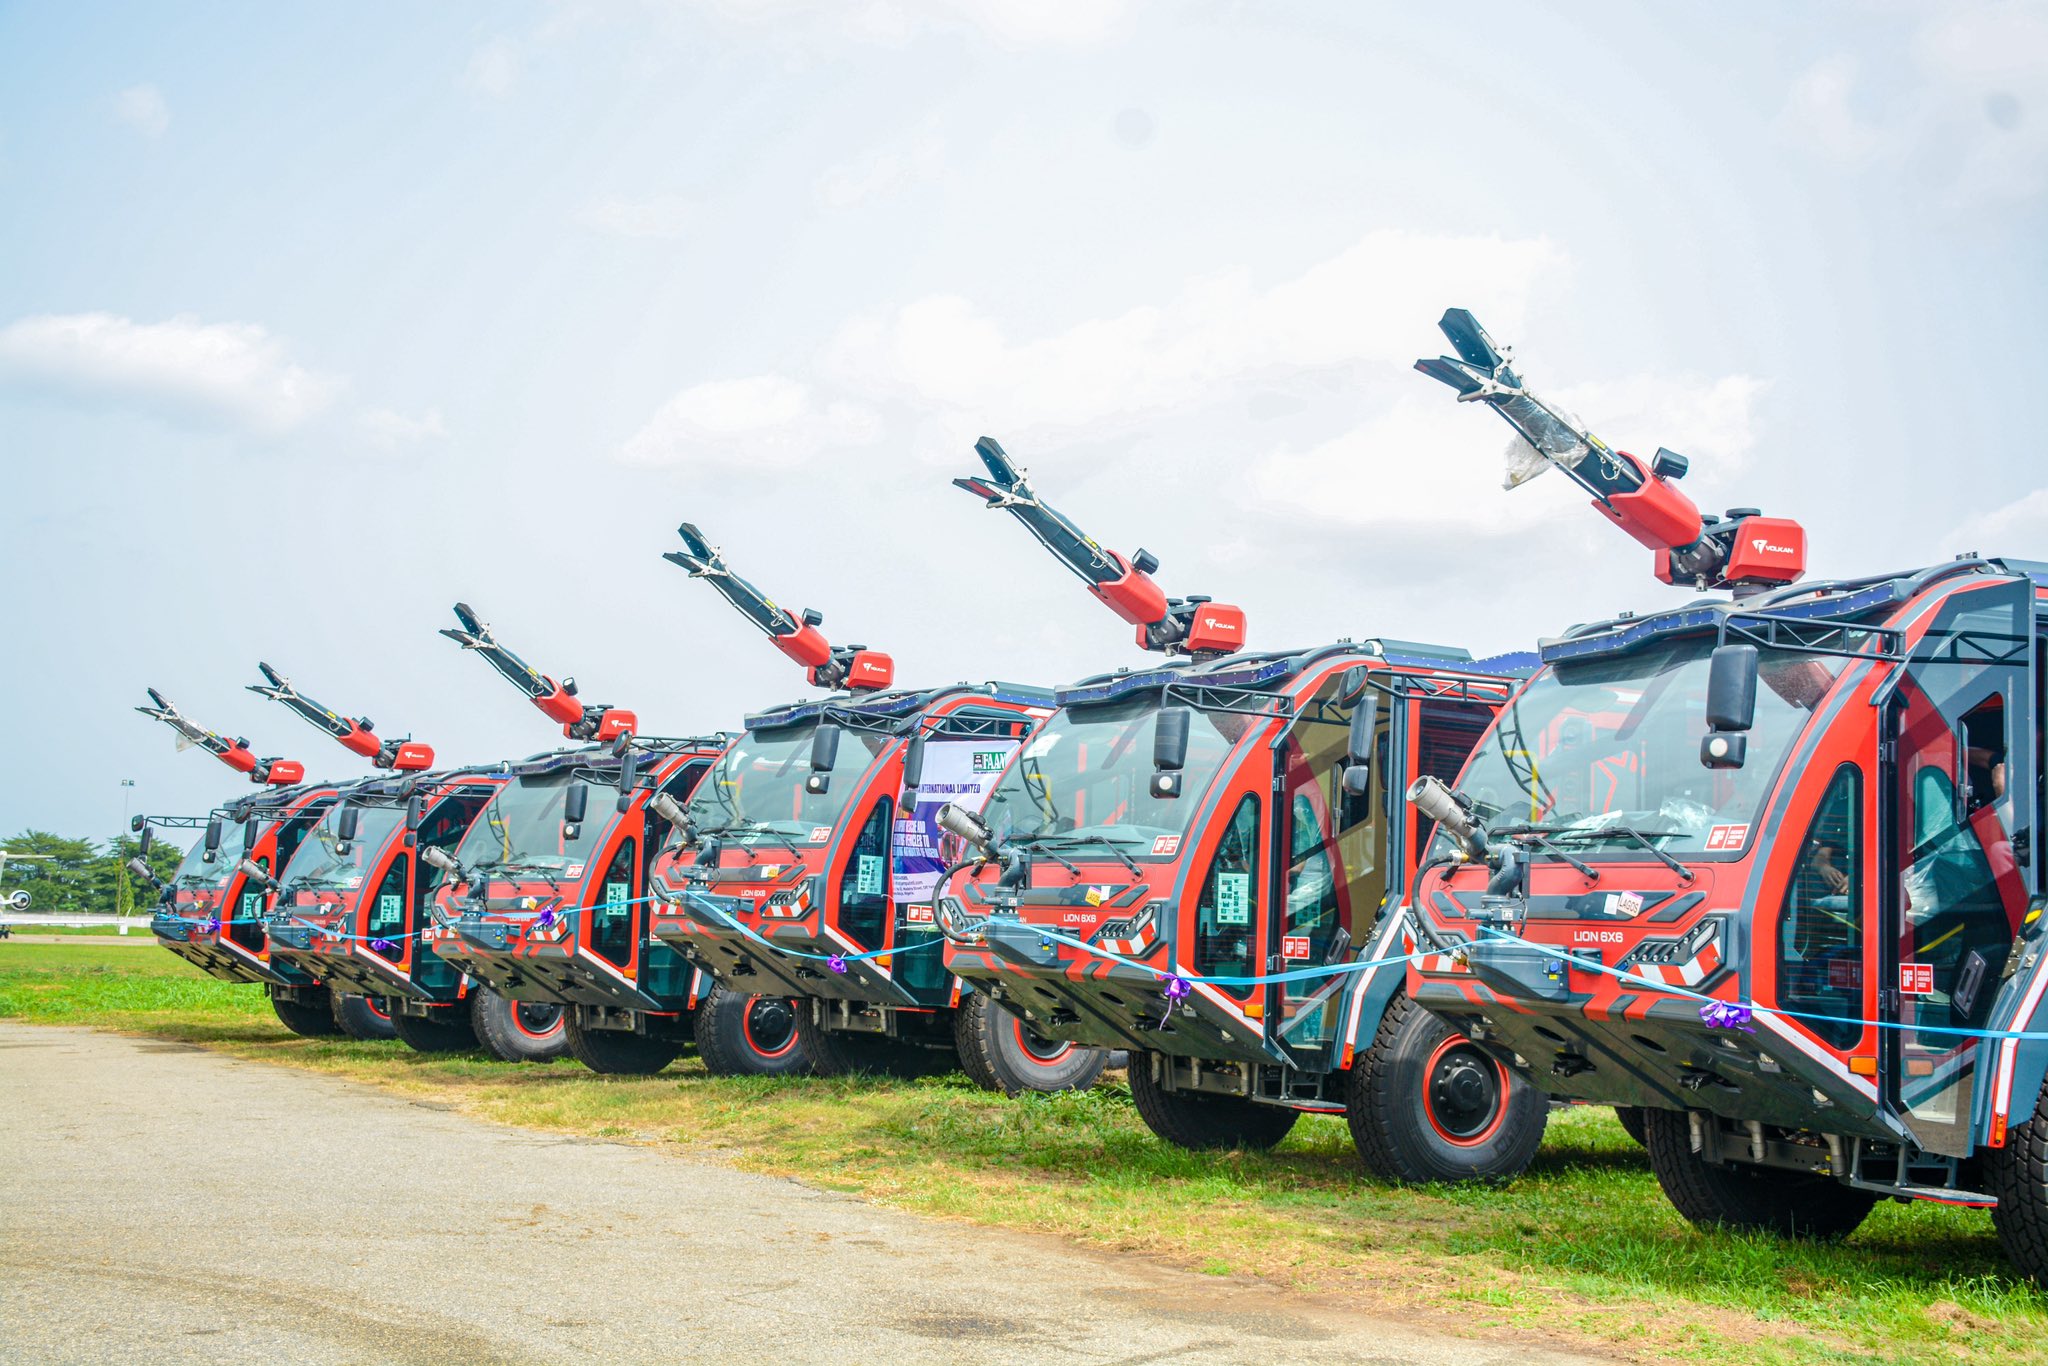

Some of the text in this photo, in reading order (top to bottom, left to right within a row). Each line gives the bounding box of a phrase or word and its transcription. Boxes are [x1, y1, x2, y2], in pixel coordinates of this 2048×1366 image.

[983, 753, 1006, 770] FAAN
[956, 784, 981, 793] LIMITED
[1619, 896, 1639, 913] LAGOS
[1063, 914, 1097, 923] LION 6X6
[1573, 931, 1624, 943] LION 6X6
